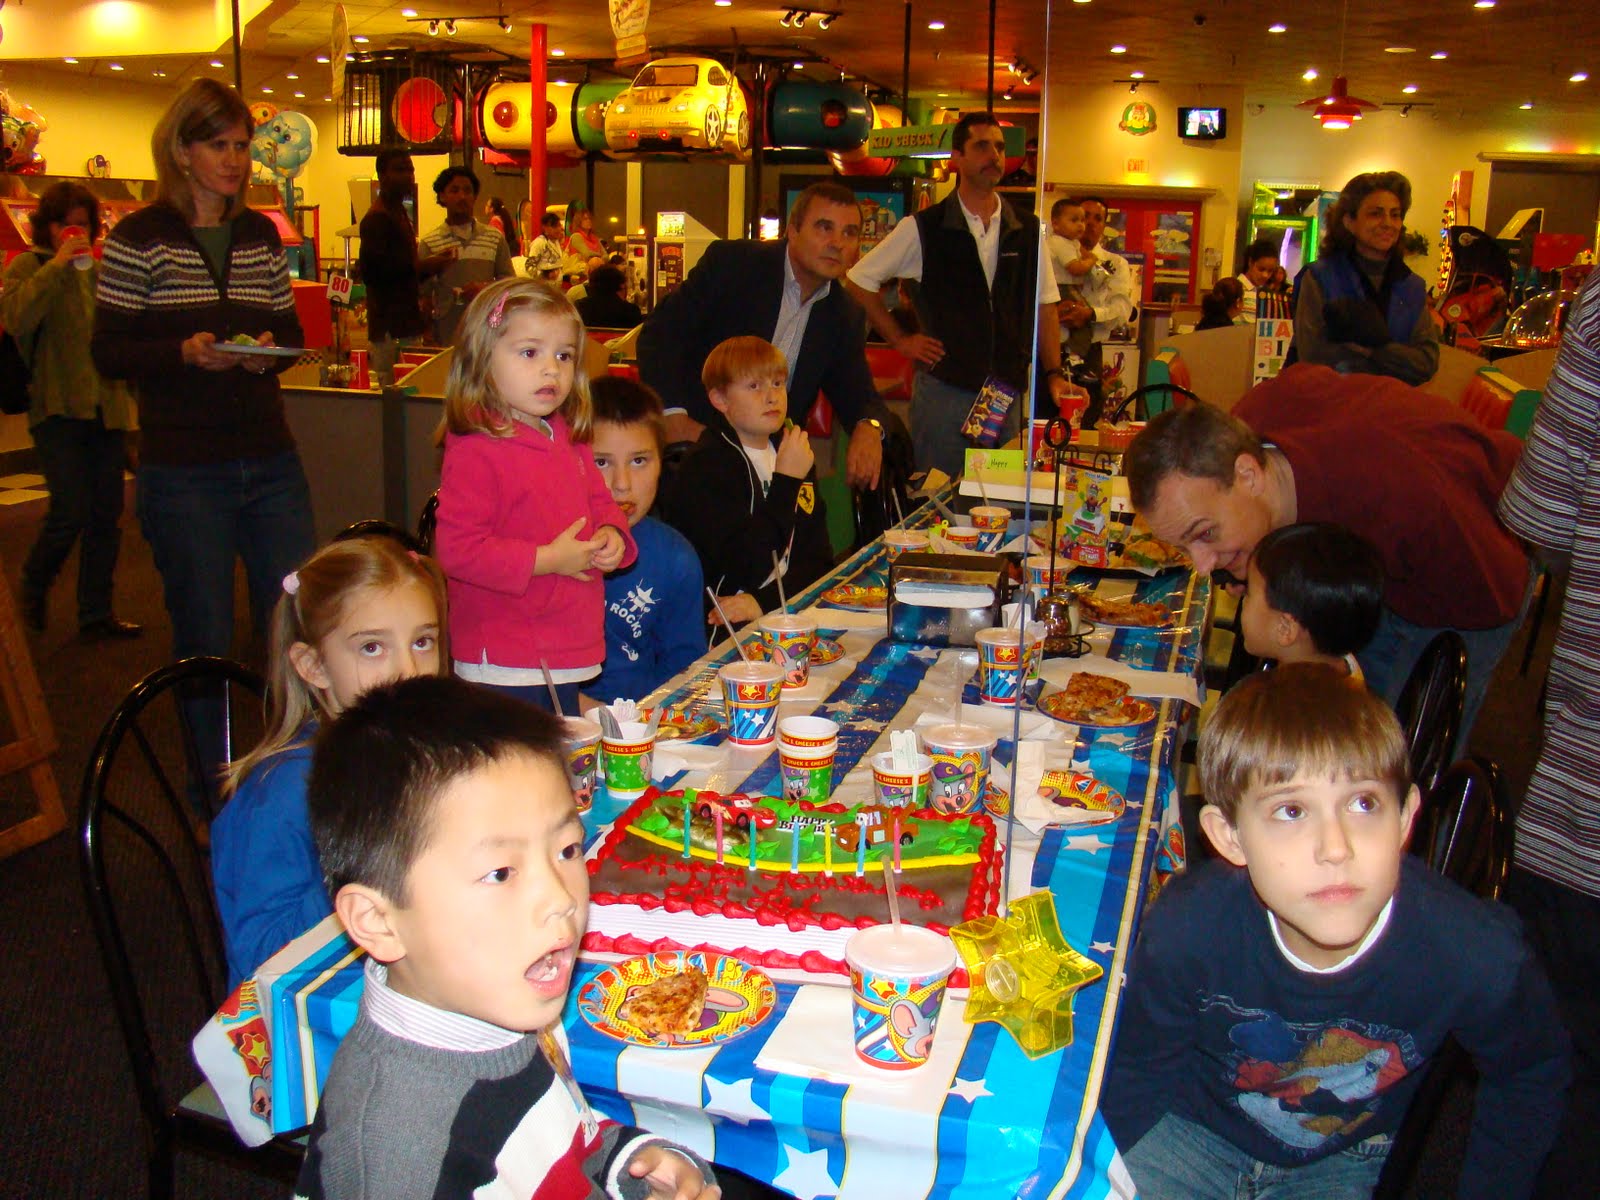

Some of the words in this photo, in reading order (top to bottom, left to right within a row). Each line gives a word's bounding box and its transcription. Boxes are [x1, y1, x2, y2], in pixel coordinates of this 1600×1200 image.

[872, 136, 891, 148] KID
[895, 132, 933, 146] CHECK
[1127, 160, 1144, 172] EXIT
[332, 276, 350, 294] 80
[991, 458, 1008, 468] Happy
[609, 602, 642, 638] ROCKS
